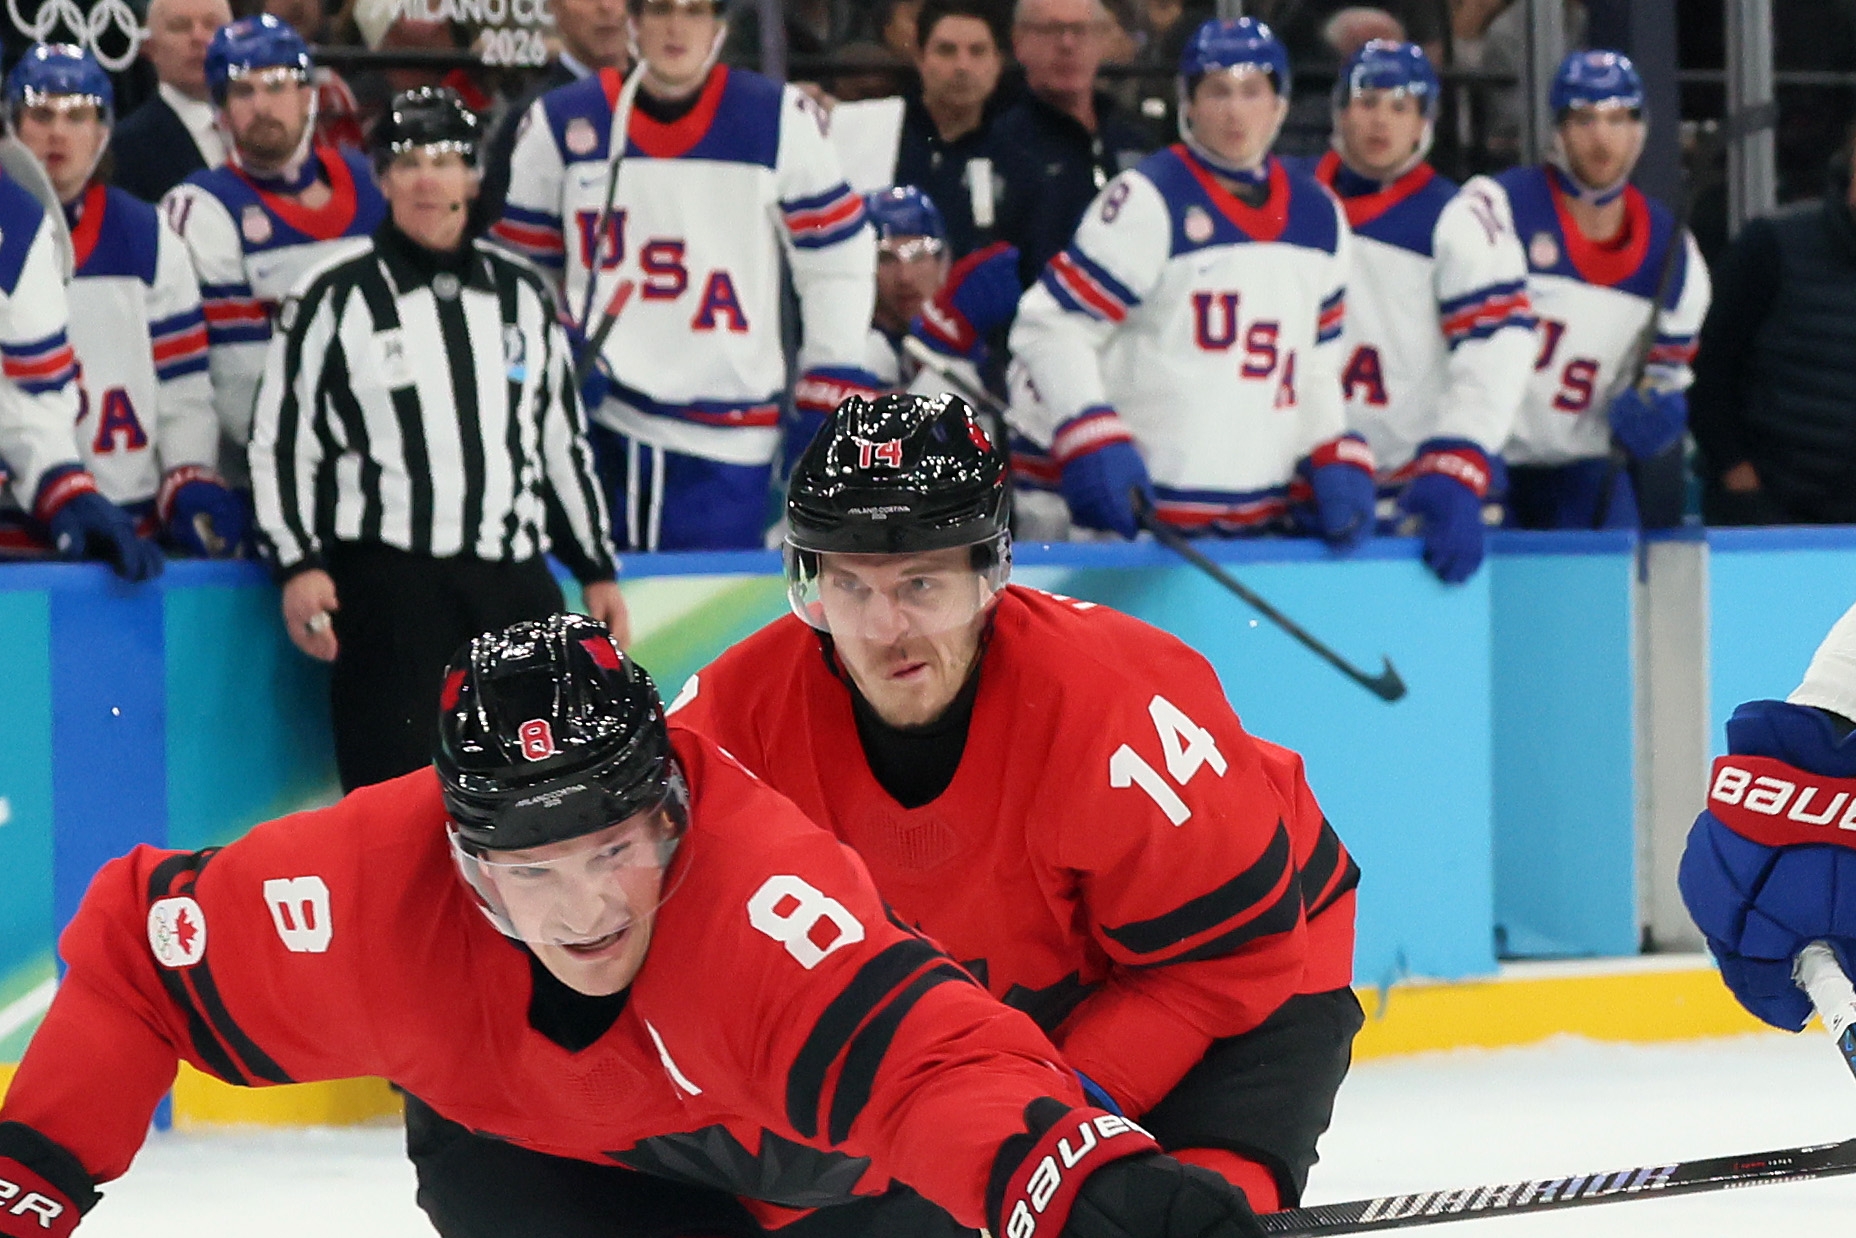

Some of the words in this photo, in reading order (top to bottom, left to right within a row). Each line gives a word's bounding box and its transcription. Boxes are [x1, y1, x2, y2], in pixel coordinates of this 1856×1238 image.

[480, 27, 548, 67] 2026
[574, 209, 750, 333] USA
[859, 438, 903, 470] 14
[517, 718, 556, 762] 8
[1109, 694, 1228, 827] 14
[263, 875, 334, 953] 8
[746, 874, 865, 970] 8
